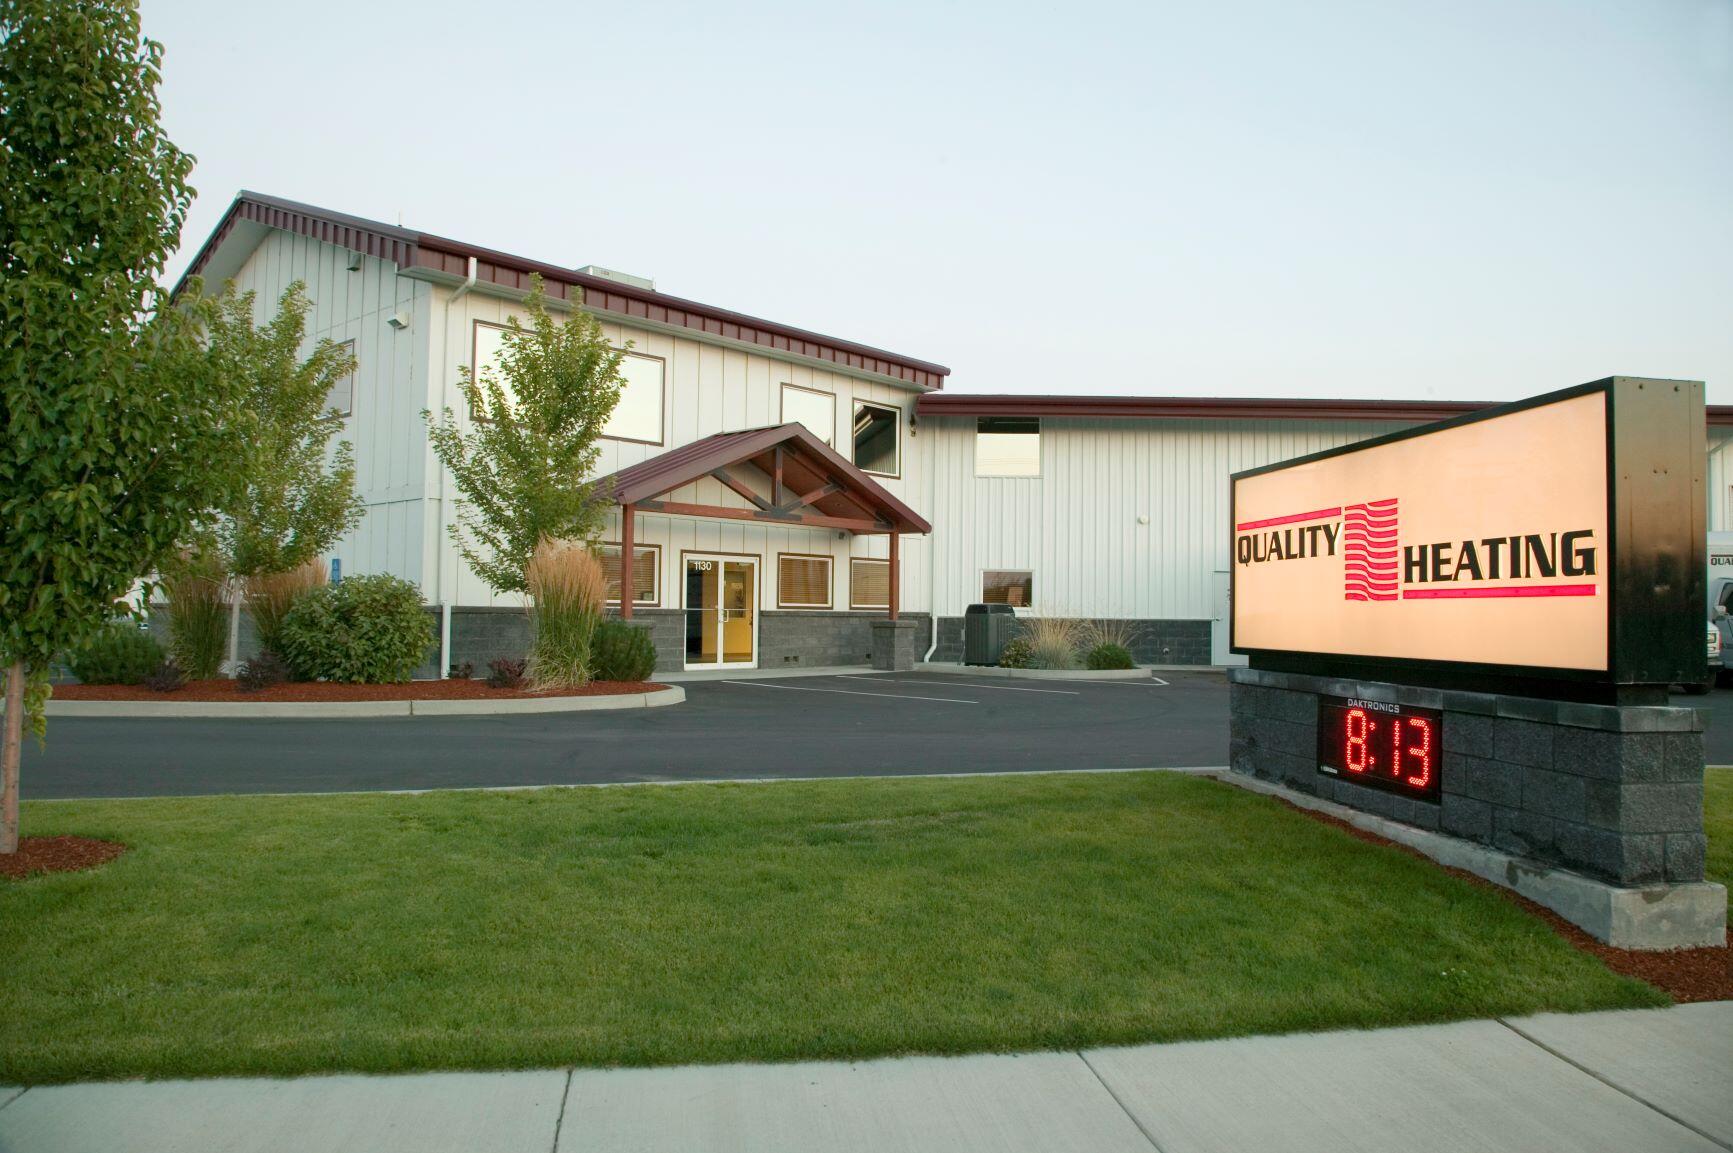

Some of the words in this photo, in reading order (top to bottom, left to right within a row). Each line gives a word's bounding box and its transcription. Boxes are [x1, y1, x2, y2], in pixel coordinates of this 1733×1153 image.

[694, 561, 712, 571] 1130
[1237, 522, 1342, 566] QUALITY
[1404, 529, 1596, 583] HEATING
[1347, 699, 1400, 713] DAKTRONICS
[1345, 709, 1429, 787] 8:13
